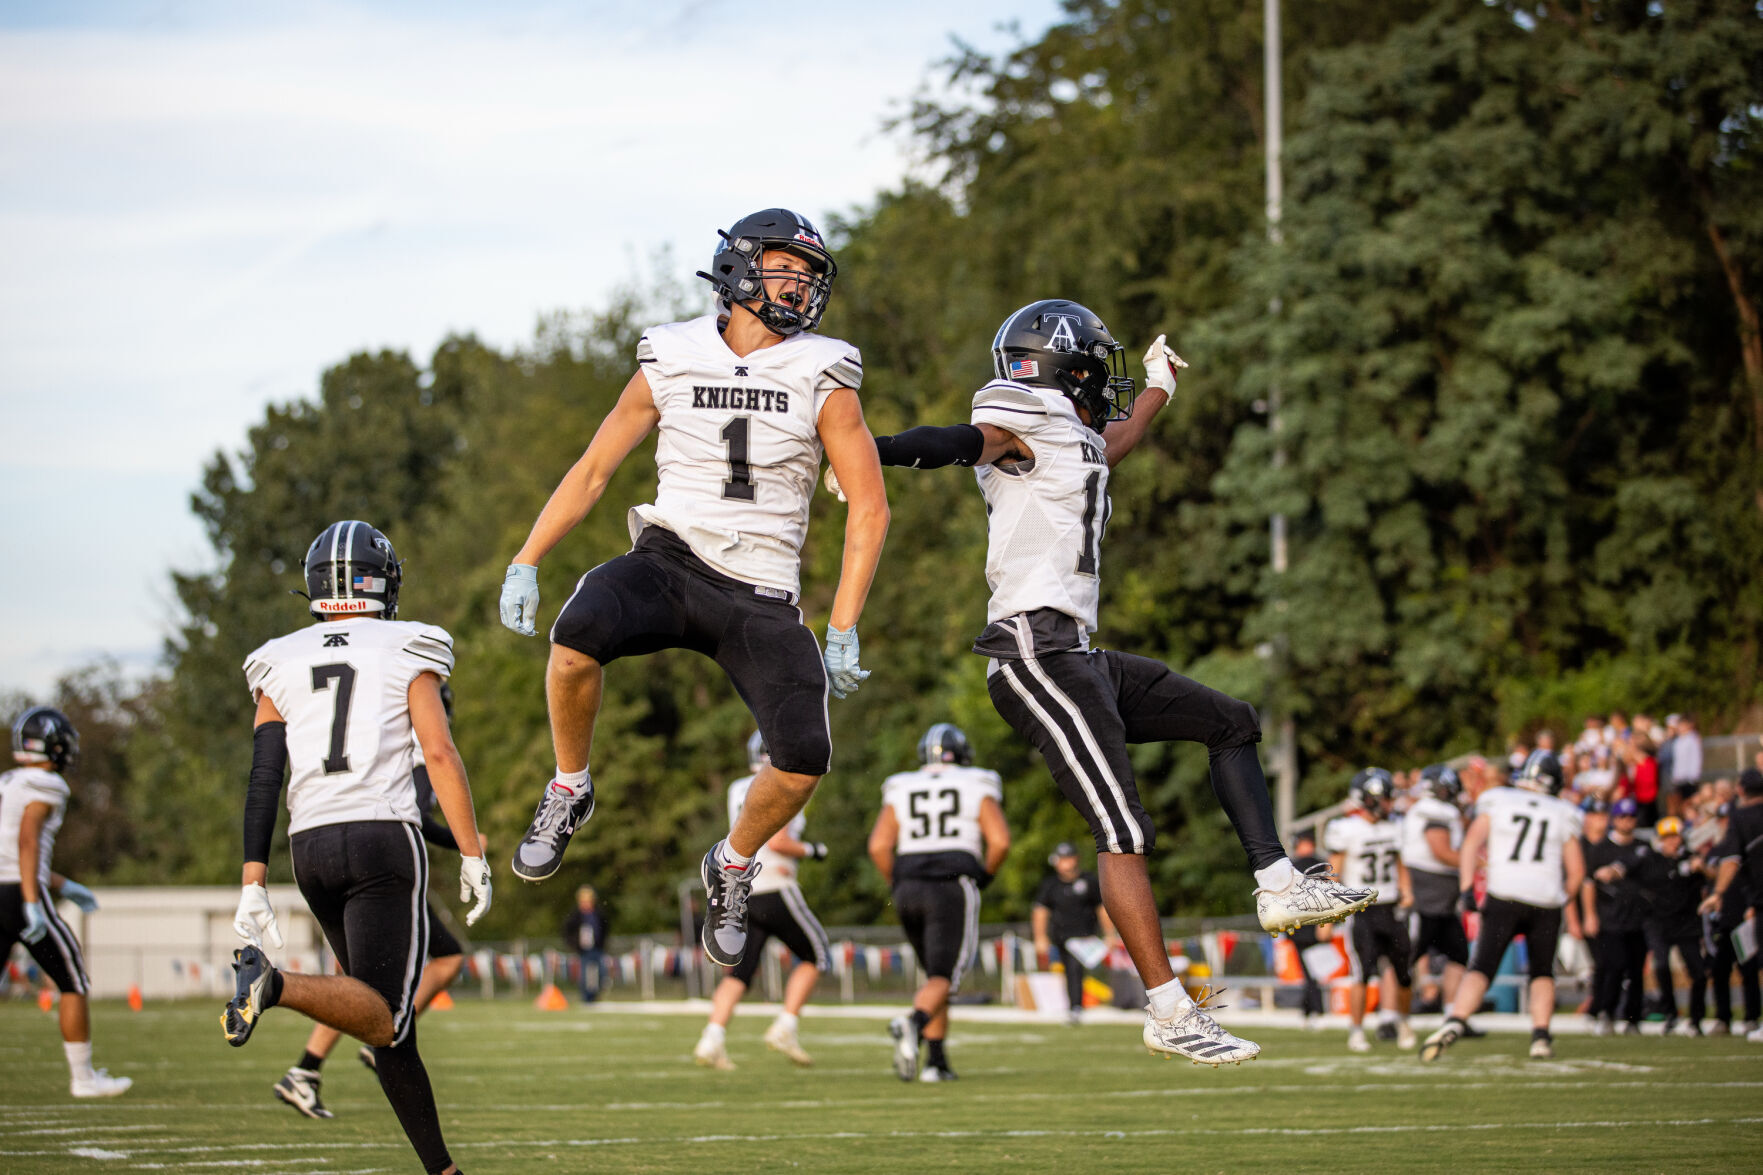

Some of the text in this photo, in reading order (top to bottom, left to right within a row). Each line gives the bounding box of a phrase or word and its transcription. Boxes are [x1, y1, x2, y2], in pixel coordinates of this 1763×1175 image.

[692, 385, 789, 413] KNIGHTS
[719, 414, 758, 504] 1
[320, 600, 367, 612] Riddell
[309, 661, 359, 776] 7
[909, 788, 960, 839] 52
[1508, 814, 1549, 863] 71
